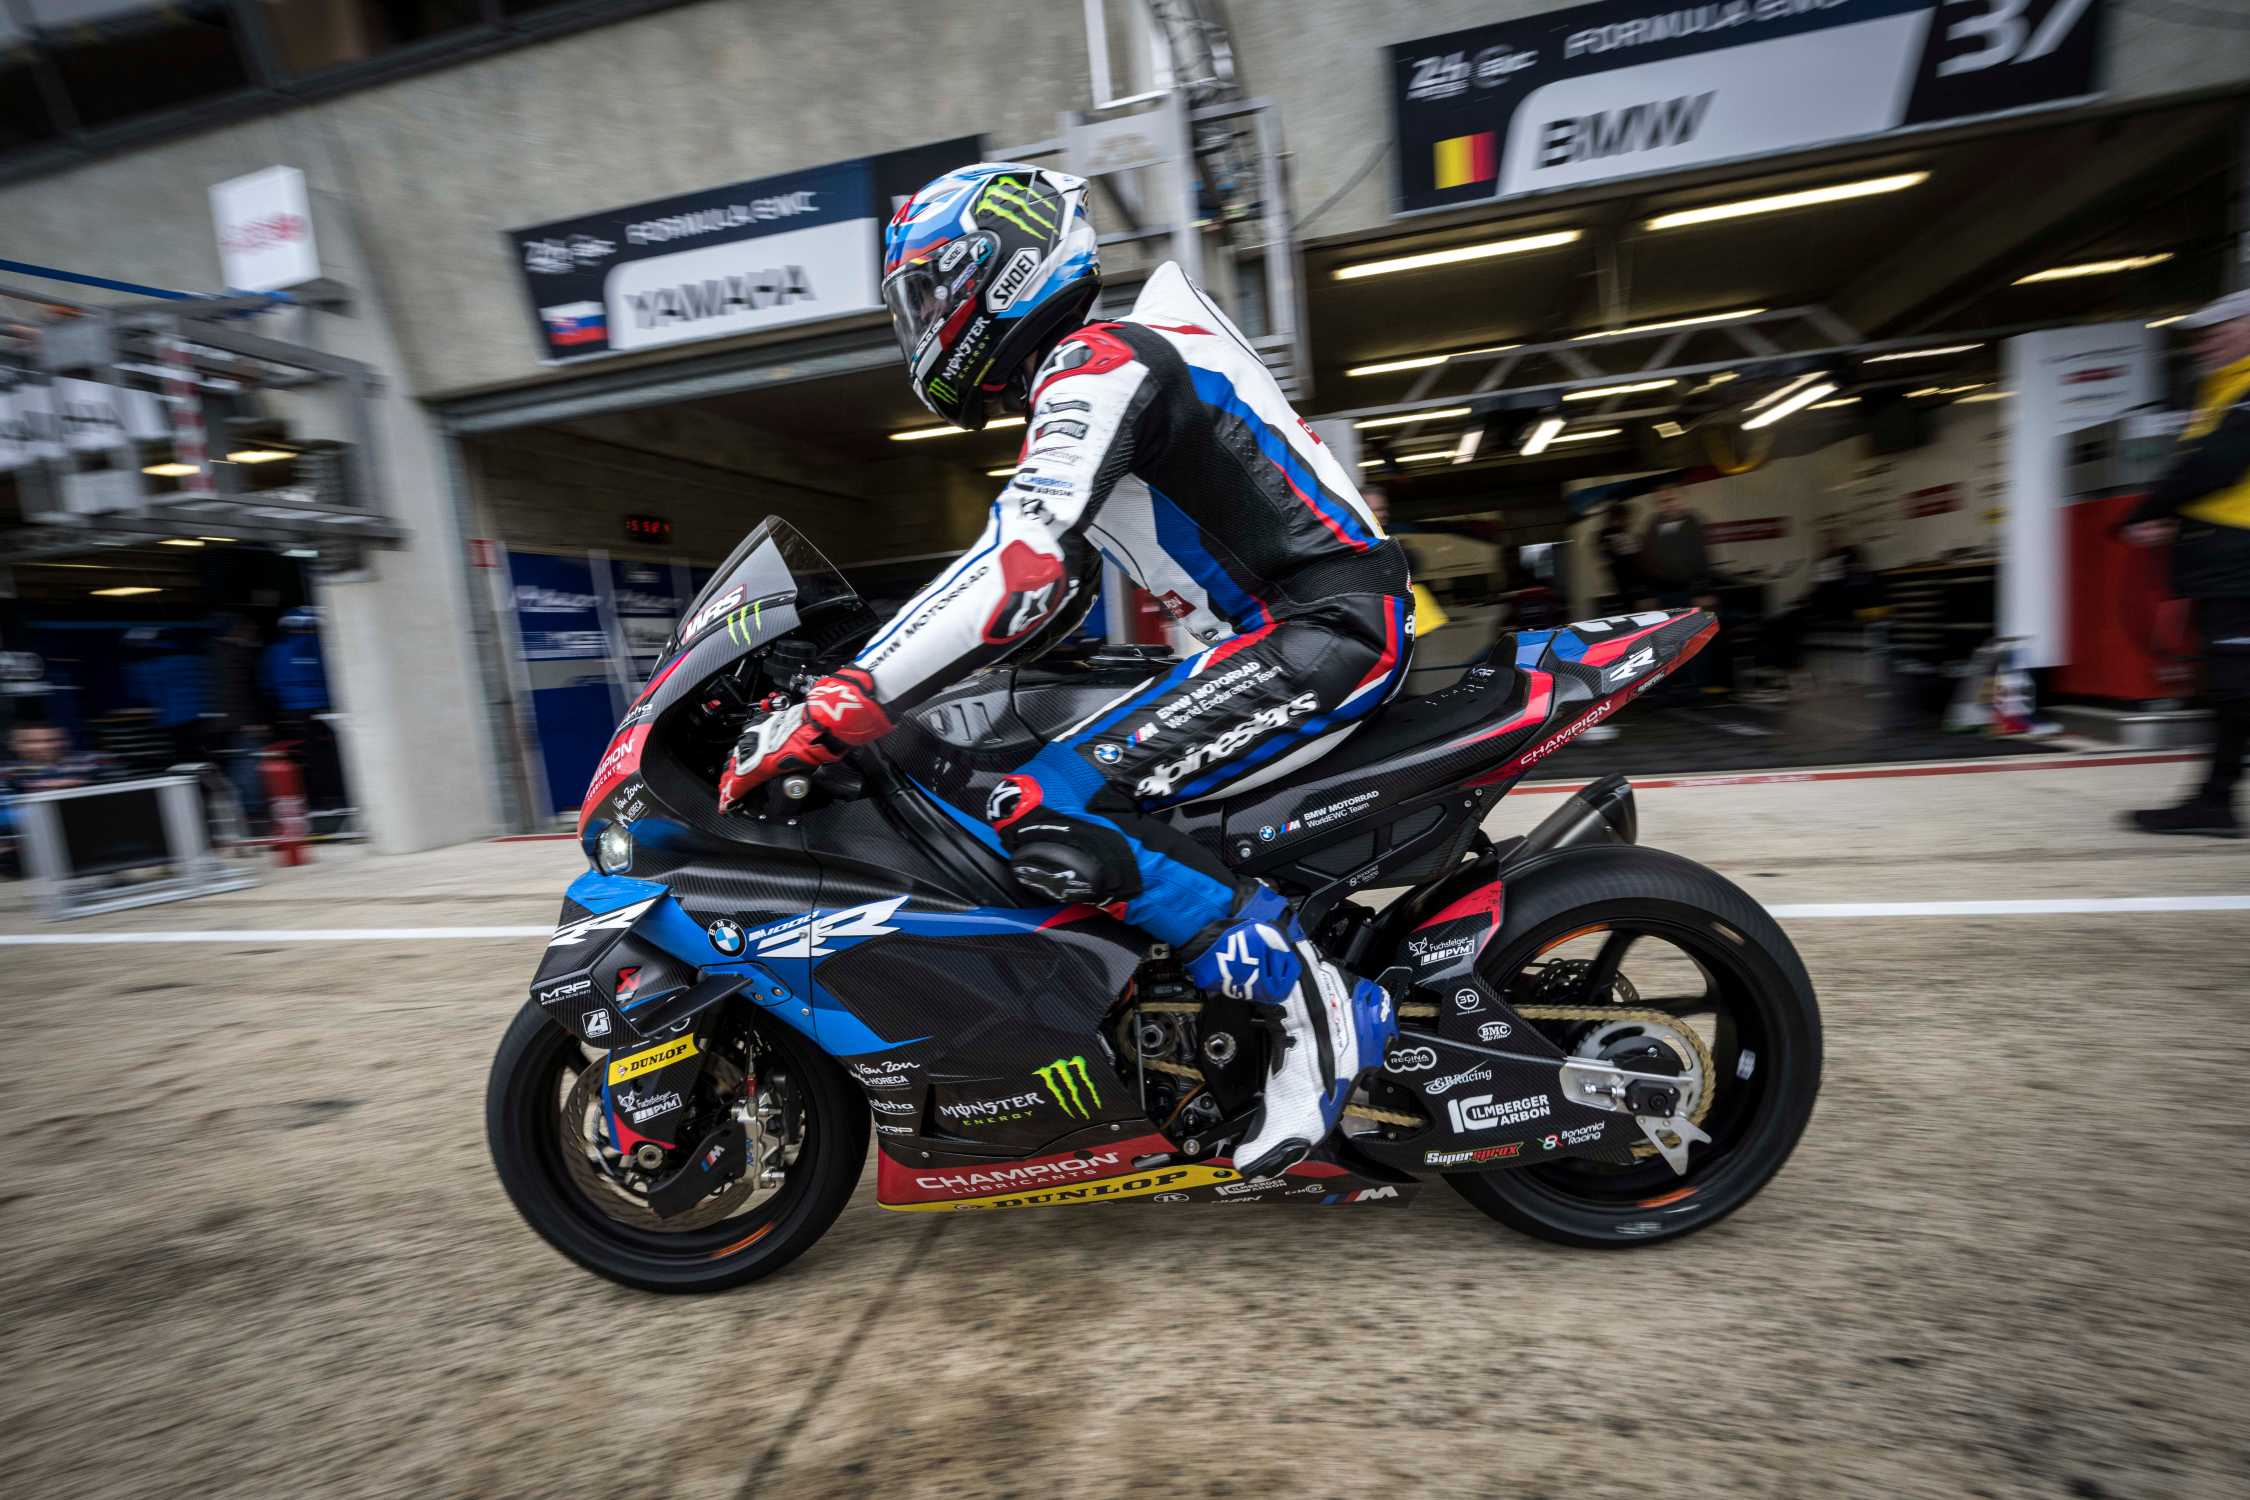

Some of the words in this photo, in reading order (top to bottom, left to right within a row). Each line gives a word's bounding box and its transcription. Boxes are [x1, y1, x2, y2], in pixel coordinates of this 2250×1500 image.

[1564, 2, 1750, 59] FORMULA
[1535, 90, 1718, 169] BMW
[993, 254, 1036, 305] SHOEI
[624, 264, 817, 330] YAMAHA
[942, 316, 991, 380] MONSTER
[686, 585, 744, 641] WRS
[904, 566, 989, 639] MOTORRAD
[1156, 695, 1192, 720] BMW
[1191, 662, 1261, 699] MOTORRAD
[1200, 680, 1256, 711] Endurance
[1252, 665, 1284, 684] Team
[1520, 701, 1611, 765] CHAMPION
[1303, 807, 1327, 821] BMW
[1328, 790, 1380, 813] MOTORRAD
[1306, 810, 1348, 829] WorldEWC
[1348, 802, 1370, 815] Team
[709, 919, 738, 936] BMW
[1446, 945, 1470, 957] PVM
[540, 980, 591, 1003] MRP
[1458, 994, 1476, 1005] 3D
[1482, 1025, 1509, 1036] BMC
[630, 1043, 687, 1071] DUNLOP
[881, 1061, 920, 1073] Zon
[653, 1098, 677, 1113] PVM
[939, 1092, 1046, 1118] MONSTER
[962, 1110, 1034, 1126] ENERGY
[1471, 1094, 1548, 1120] ILMBERGER
[1568, 1132, 1601, 1146] Racing
[916, 1152, 1119, 1189] CHAMPION
[951, 1169, 1097, 1194] LUBRICANTS
[990, 1169, 1188, 1208] DUNLOP
